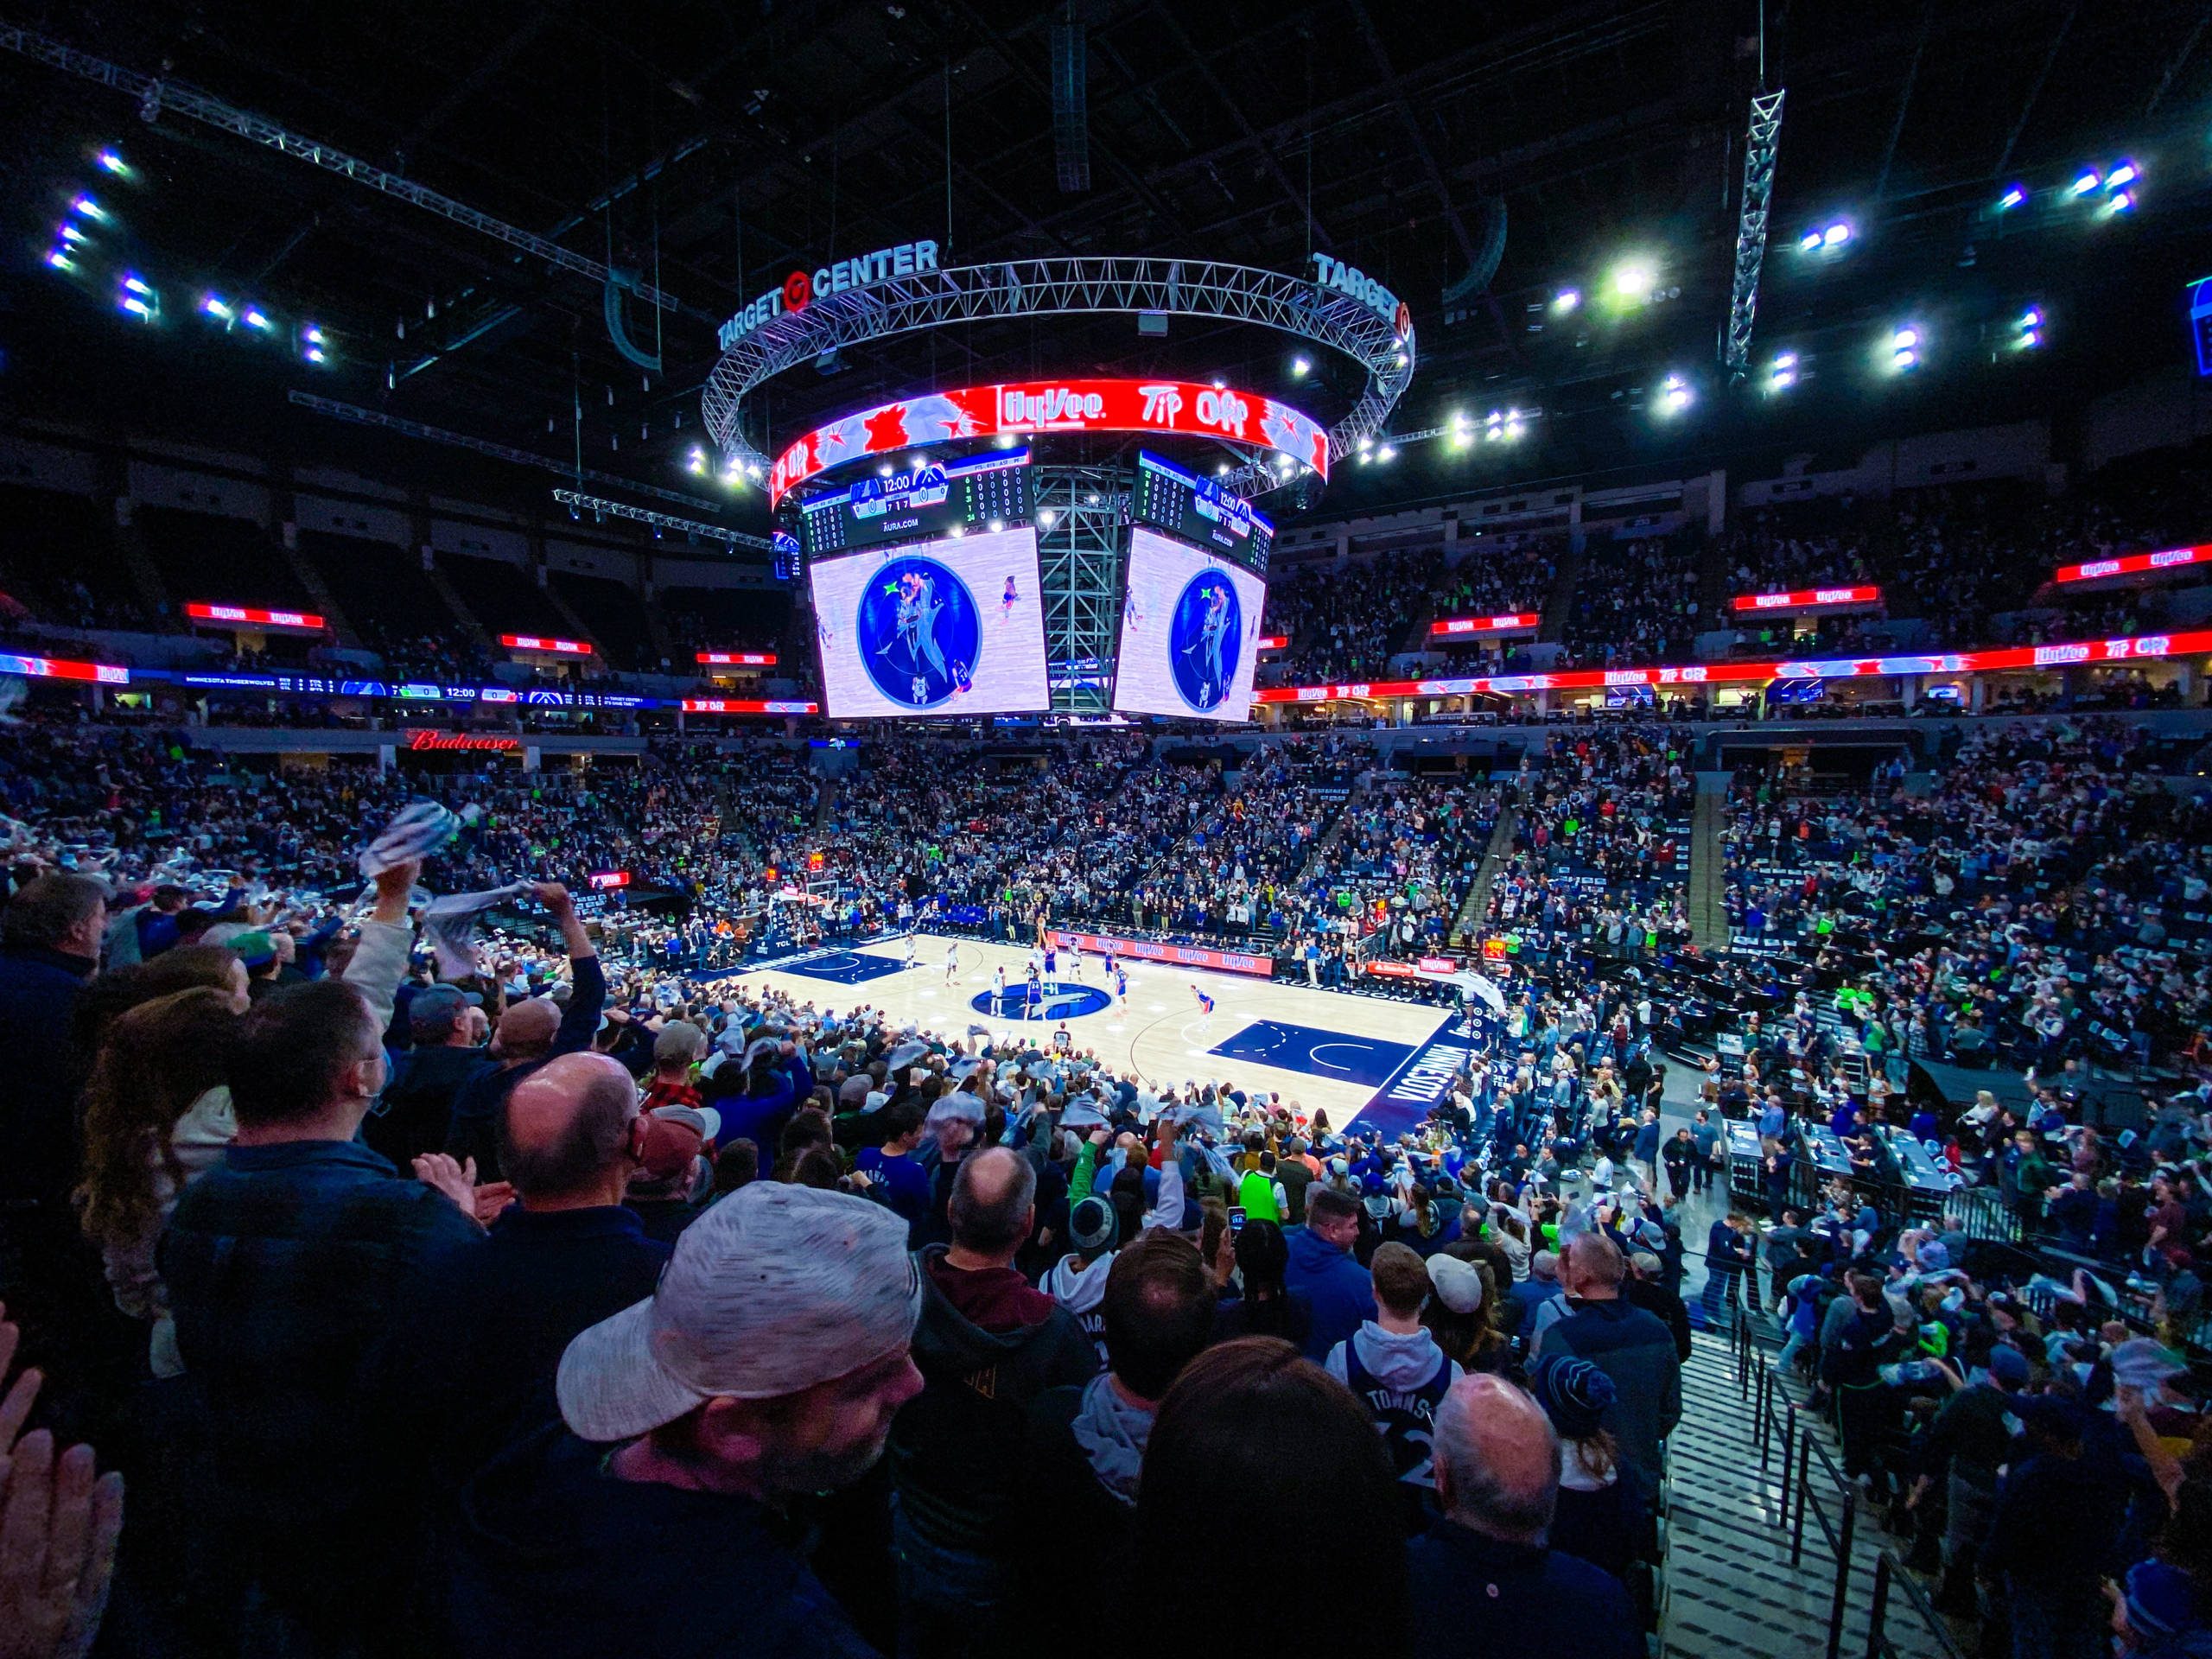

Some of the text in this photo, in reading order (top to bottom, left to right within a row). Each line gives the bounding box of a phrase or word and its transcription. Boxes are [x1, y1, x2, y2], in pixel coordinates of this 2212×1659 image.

[718, 239, 939, 351] TARGET CENTER
[1313, 251, 1399, 323] TARGET
[1139, 386, 1184, 429] Tip
[1196, 391, 1249, 437] Off
[976, 474, 982, 482] 0
[989, 471, 995, 480] 0
[1002, 469, 1007, 478] 0
[1015, 467, 1020, 475] 0
[883, 475, 910, 493] 12:00
[978, 483, 983, 492] 0
[1003, 479, 1008, 487] 0
[1004, 488, 1009, 497] 0
[896, 501, 900, 512] 1
[980, 502, 985, 511] 0
[1005, 498, 1010, 506] 0
[1018, 496, 1023, 505] 0
[1006, 507, 1011, 516] 0
[1019, 505, 1024, 514] 0
[1221, 493, 1236, 511] 12:00
[447, 688, 475, 697] 12:00
[407, 730, 518, 751] Budweiser
[1388, 1043, 1469, 1103] MINNESOTA
[1366, 1389, 1430, 1421] TOWNS
